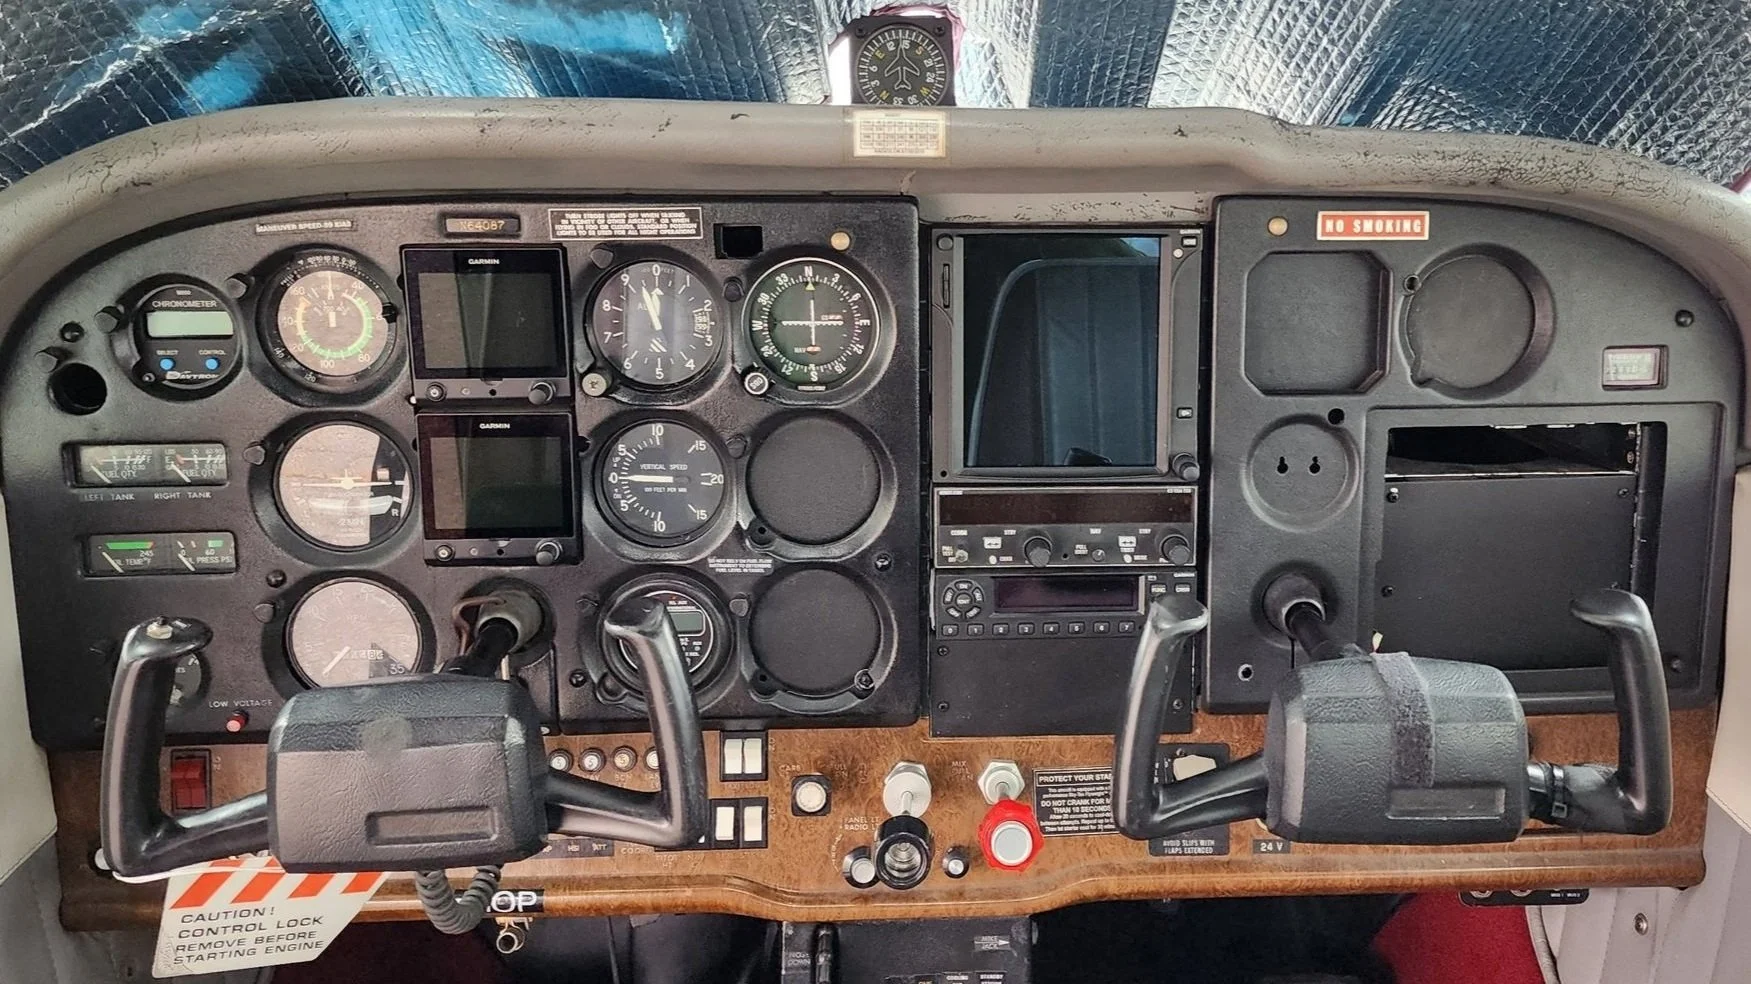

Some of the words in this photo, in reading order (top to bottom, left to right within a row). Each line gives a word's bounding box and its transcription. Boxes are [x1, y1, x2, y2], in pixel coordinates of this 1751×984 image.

[887, 41, 896, 51] 12
[902, 40, 910, 49] 15
[875, 50, 885, 59] E
[916, 46, 924, 55] S
[924, 58, 933, 67] 21
[926, 72, 935, 83] 24
[880, 90, 889, 100] N
[920, 87, 931, 97] W
[908, 94, 917, 104] 30
[459, 220, 505, 230] N64087
[1326, 219, 1344, 233] NO
[1353, 219, 1421, 233] SMOKING
[652, 264, 660, 276] 0
[804, 266, 813, 276] N
[621, 274, 629, 285] 9
[775, 273, 789, 285] 33
[832, 273, 840, 283] 3
[152, 300, 217, 308] CHRONOMETER
[603, 300, 611, 311] 8
[704, 300, 712, 312] 2
[752, 320, 763, 331] W
[604, 332, 612, 343] 7
[705, 335, 712, 346] 3
[623, 358, 632, 369] 6
[684, 359, 696, 370] 4
[656, 368, 664, 379] 5
[810, 371, 818, 381] S
[651, 425, 664, 436] 10
[618, 444, 626, 456] 5
[695, 441, 707, 450] 15
[611, 472, 618, 483] 0
[711, 474, 724, 484] 20
[620, 501, 629, 511] 5
[696, 510, 707, 520] 15
[654, 521, 666, 532] 10
[390, 664, 404, 674] 35
[1260, 842, 1273, 852] 24
[1276, 842, 1283, 851] V
[181, 907, 275, 924] CAUTION!
[178, 922, 268, 939] CONTROL
[277, 916, 324, 929] LOCK
[176, 938, 247, 953] REMOVE
[254, 931, 317, 945] BEFORE
[174, 948, 257, 965] STARTING
[265, 940, 323, 955] ENGINE
